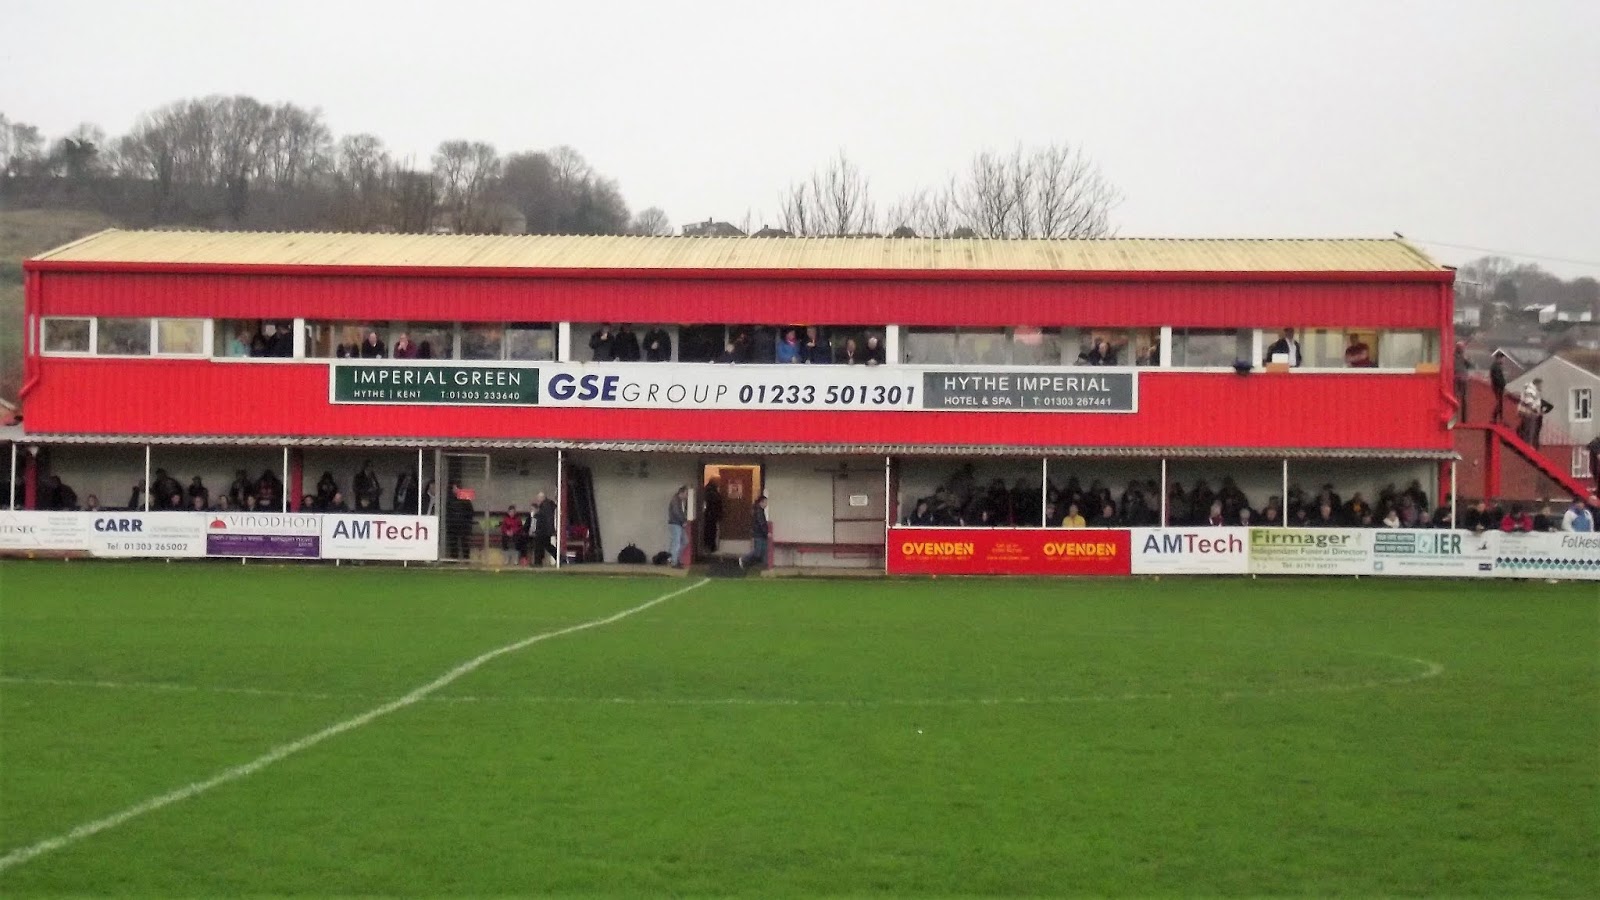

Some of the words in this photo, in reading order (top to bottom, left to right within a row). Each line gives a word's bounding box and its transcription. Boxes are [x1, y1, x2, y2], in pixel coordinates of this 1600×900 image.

[353, 370, 447, 385] IMPERIAL
[454, 371, 521, 386] GREEN
[944, 376, 1010, 391] HYTHE
[1016, 377, 1111, 392] IMPERIAL
[353, 389, 385, 399] HYTHE
[396, 390, 421, 399] KENT
[484, 391, 520, 401] 233640
[738, 384, 816, 404] 01233
[824, 385, 915, 405] 501301
[944, 396, 979, 406] HOTEL
[981, 396, 988, 406] &
[991, 396, 1012, 406] SPA
[1044, 397, 1074, 407] 01303
[1076, 397, 1112, 407] 267441
[94, 518, 143, 532] CARR
[332, 520, 428, 541] AMTech
[124, 542, 152, 551] 01303
[155, 543, 188, 551] 265002
[1143, 534, 1243, 554] AMTech
[1251, 530, 1350, 548] Firmager
[902, 542, 974, 556] OVENDEN
[1043, 543, 1116, 557] OVENDEN
